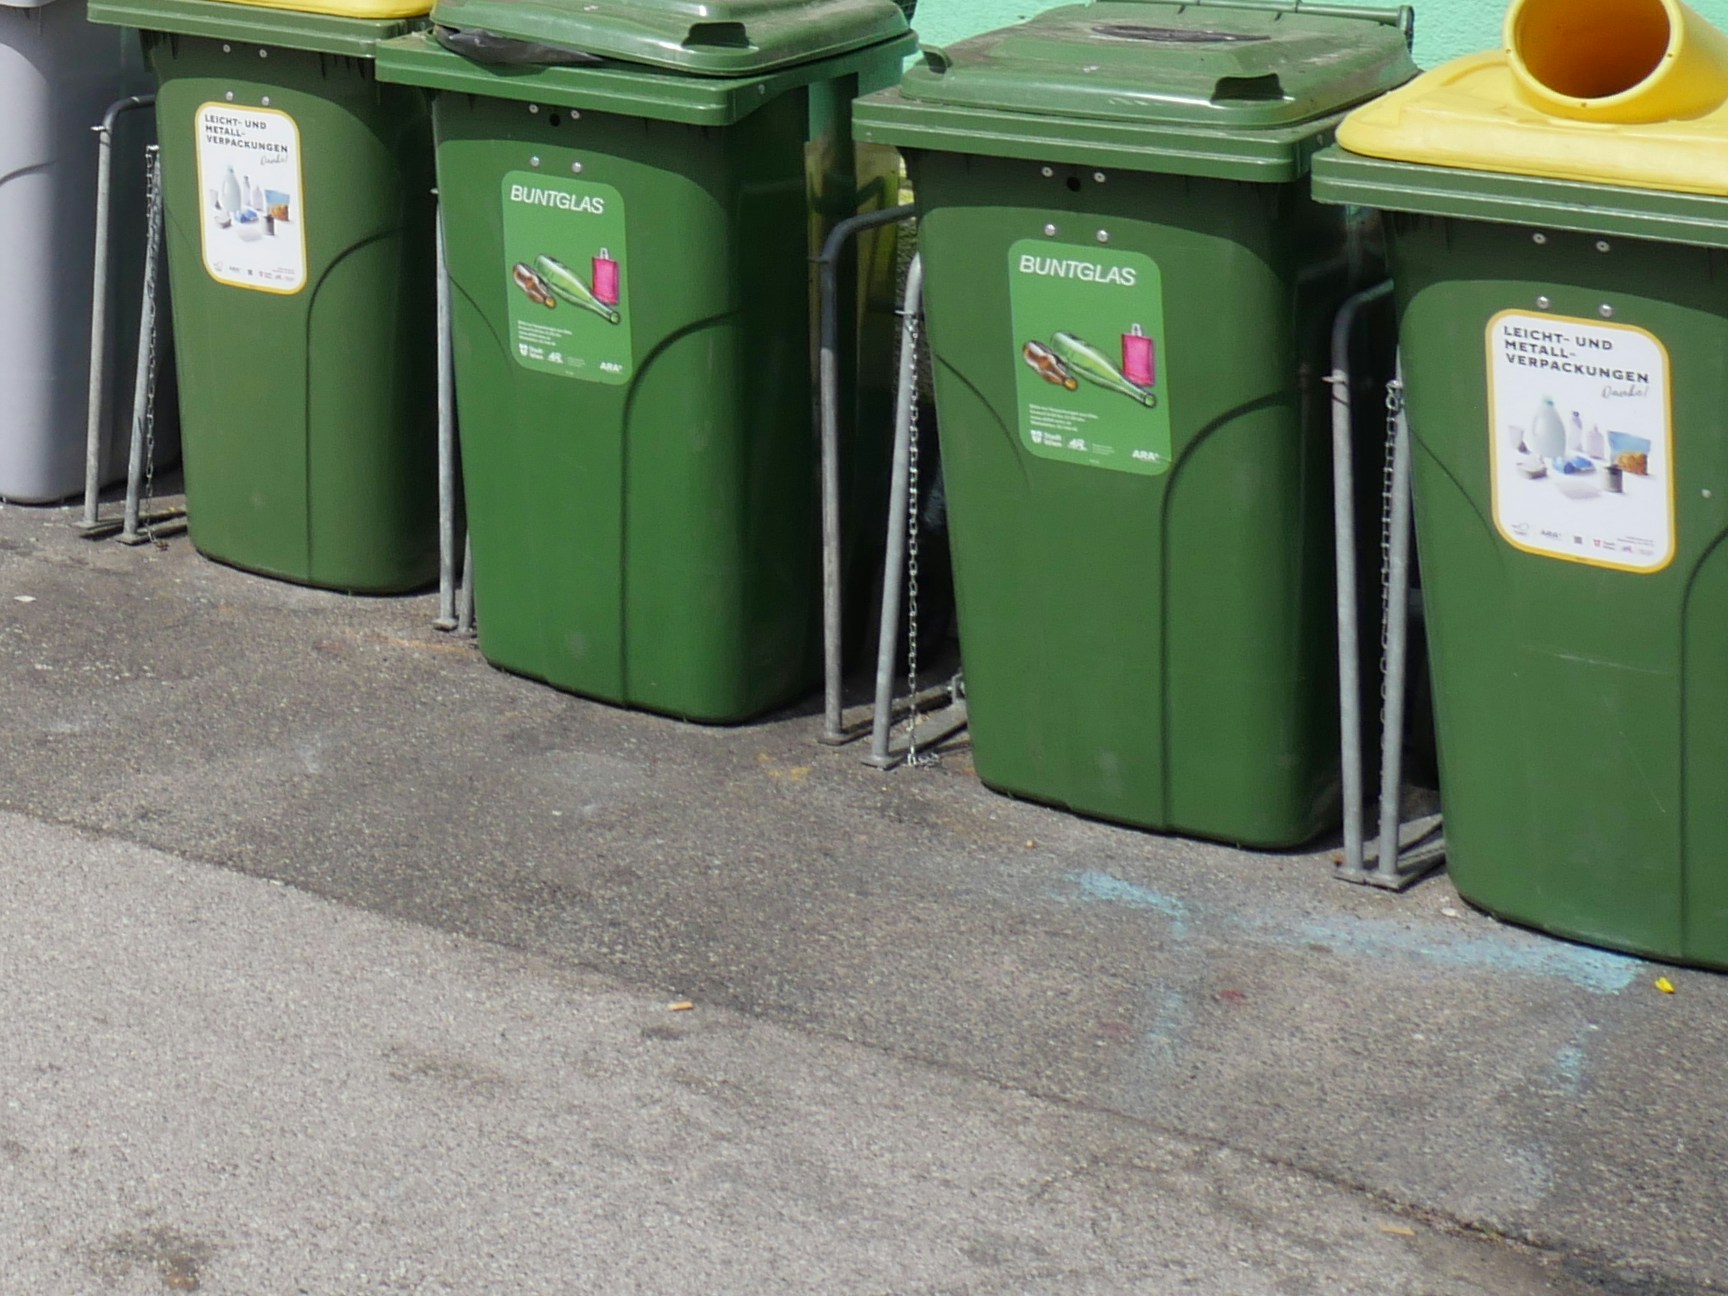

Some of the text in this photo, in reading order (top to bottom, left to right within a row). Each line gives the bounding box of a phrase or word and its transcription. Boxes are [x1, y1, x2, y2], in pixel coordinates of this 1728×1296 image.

[205, 114, 267, 130] LEICHT- UND
[205, 125, 246, 137] METALL-
[206, 135, 288, 153] VERPACKUNGEN
[510, 185, 604, 214] BUNTGLAS
[1019, 255, 1136, 286] BUNTGLAS
[1503, 325, 1613, 351] LEICHT- UND
[1504, 339, 1576, 358] METALL-
[1506, 353, 1649, 384] VERPACKUNGEN
